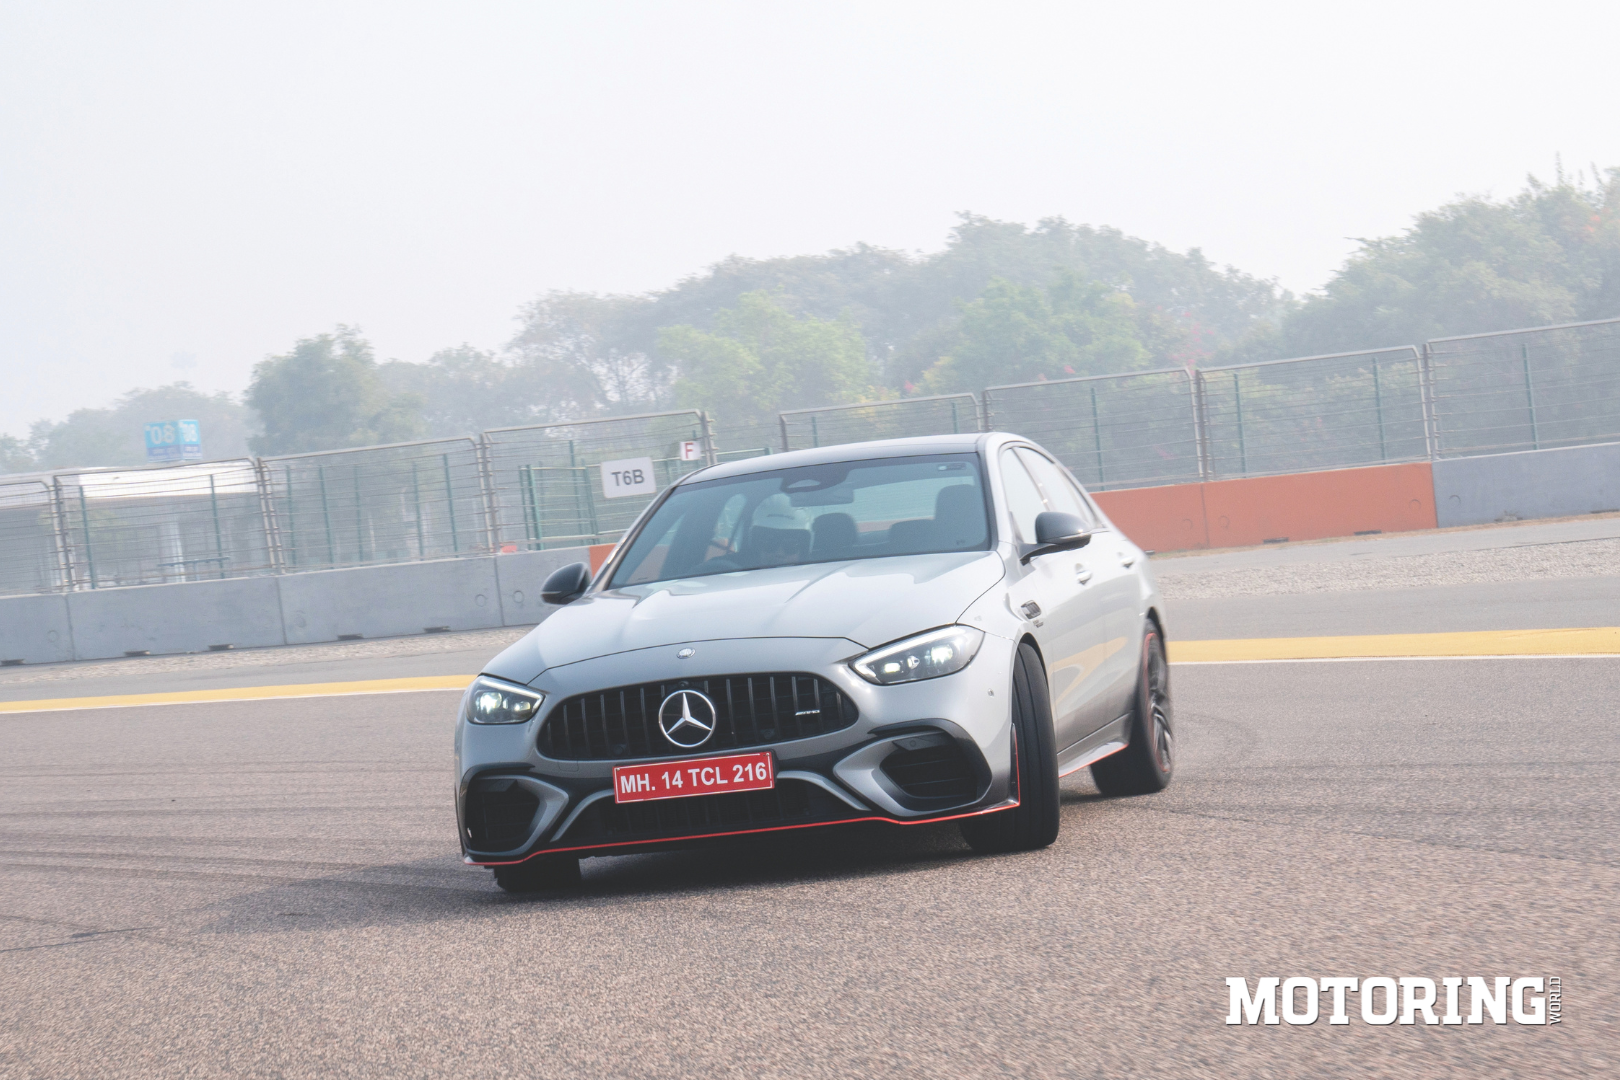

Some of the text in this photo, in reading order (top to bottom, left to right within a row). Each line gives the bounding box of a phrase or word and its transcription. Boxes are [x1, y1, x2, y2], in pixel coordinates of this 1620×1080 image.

[684, 442, 694, 459] F
[611, 469, 645, 486] T6B
[620, 762, 767, 794] MH. 14 TCL 216
